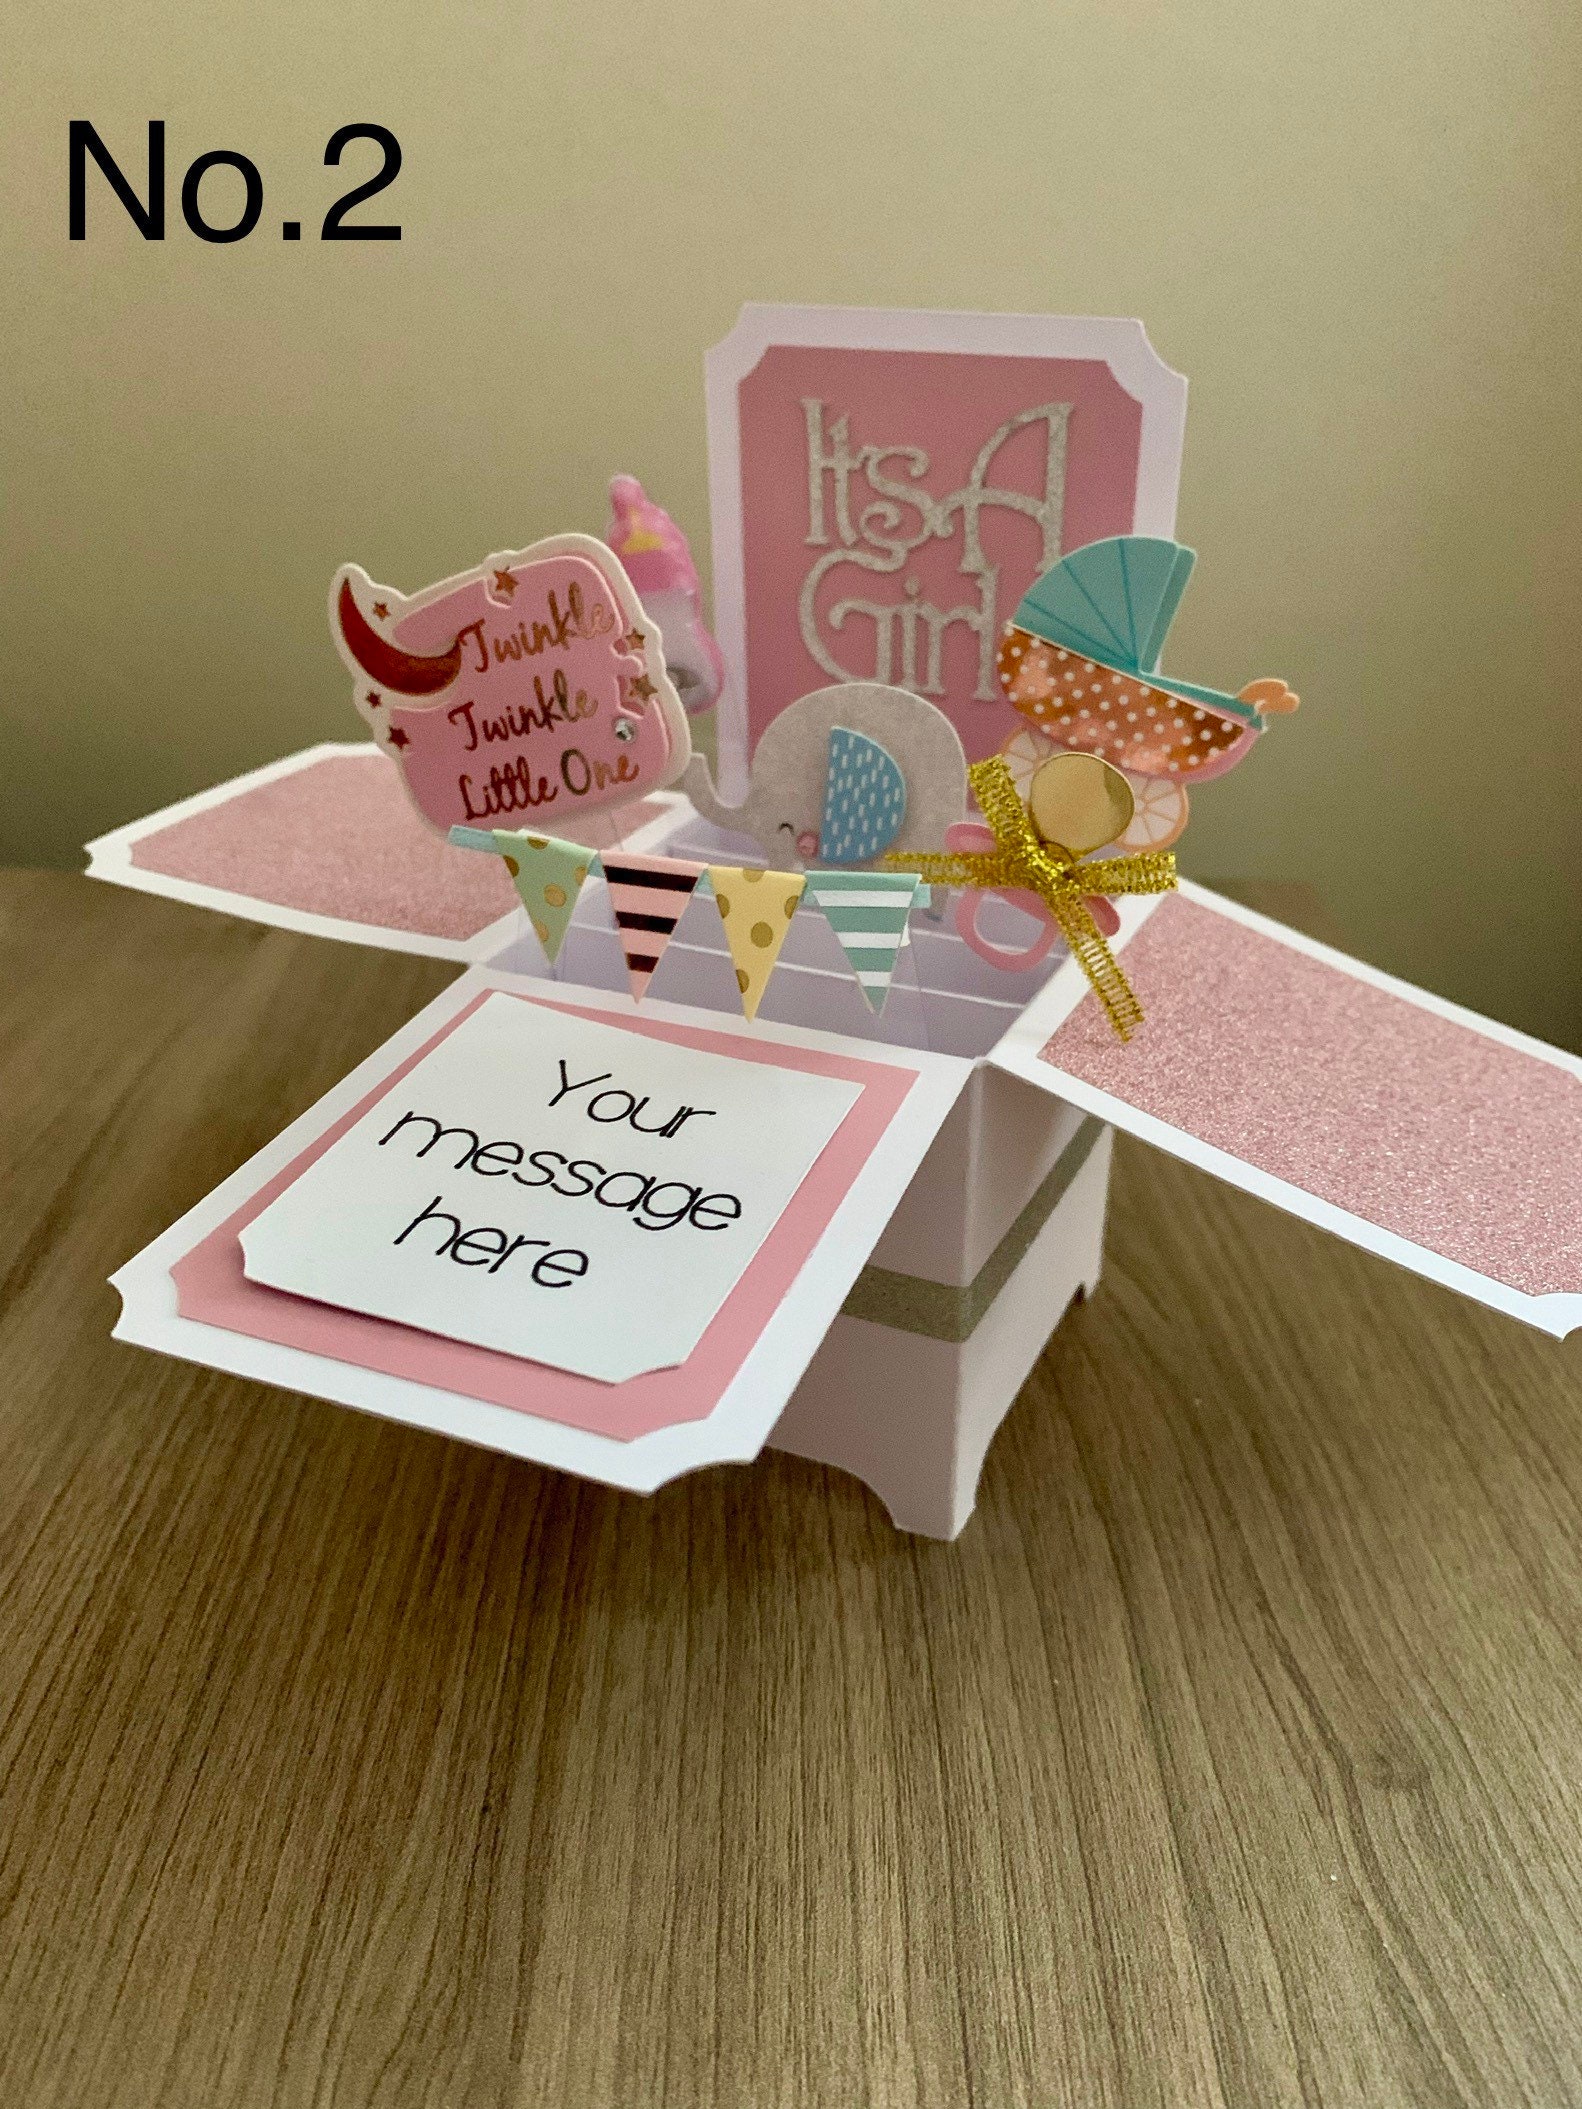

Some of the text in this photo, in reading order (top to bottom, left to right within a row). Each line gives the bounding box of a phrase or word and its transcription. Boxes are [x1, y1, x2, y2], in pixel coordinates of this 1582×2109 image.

[936, 402, 1075, 574] A
[457, 581, 615, 673] Twinkle
[799, 546, 998, 702] Girl
[447, 669, 599, 752] Twinkle
[458, 748, 640, 821] Little One
[548, 1059, 717, 1138] Your
[378, 1110, 742, 1231] message
[393, 1195, 589, 1288] here
